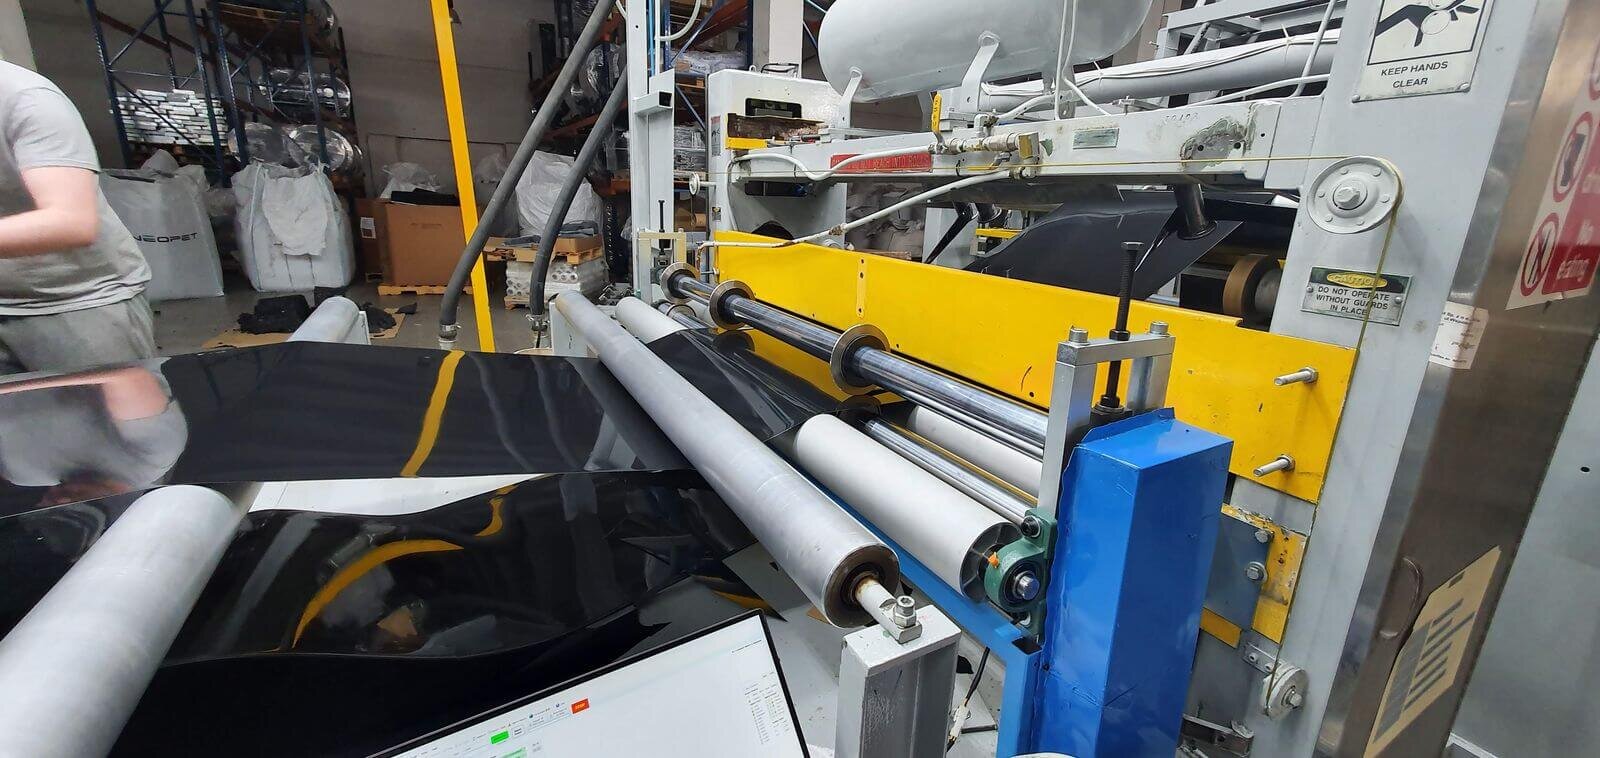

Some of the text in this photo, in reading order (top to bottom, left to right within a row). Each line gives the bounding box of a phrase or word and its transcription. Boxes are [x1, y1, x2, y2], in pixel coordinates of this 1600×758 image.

[1381, 61, 1448, 76] KEEP HANDS
[1393, 77, 1428, 88] CLEAR
[1316, 294, 1350, 304] WITHOUT
[1341, 306, 1367, 316] PLACE
